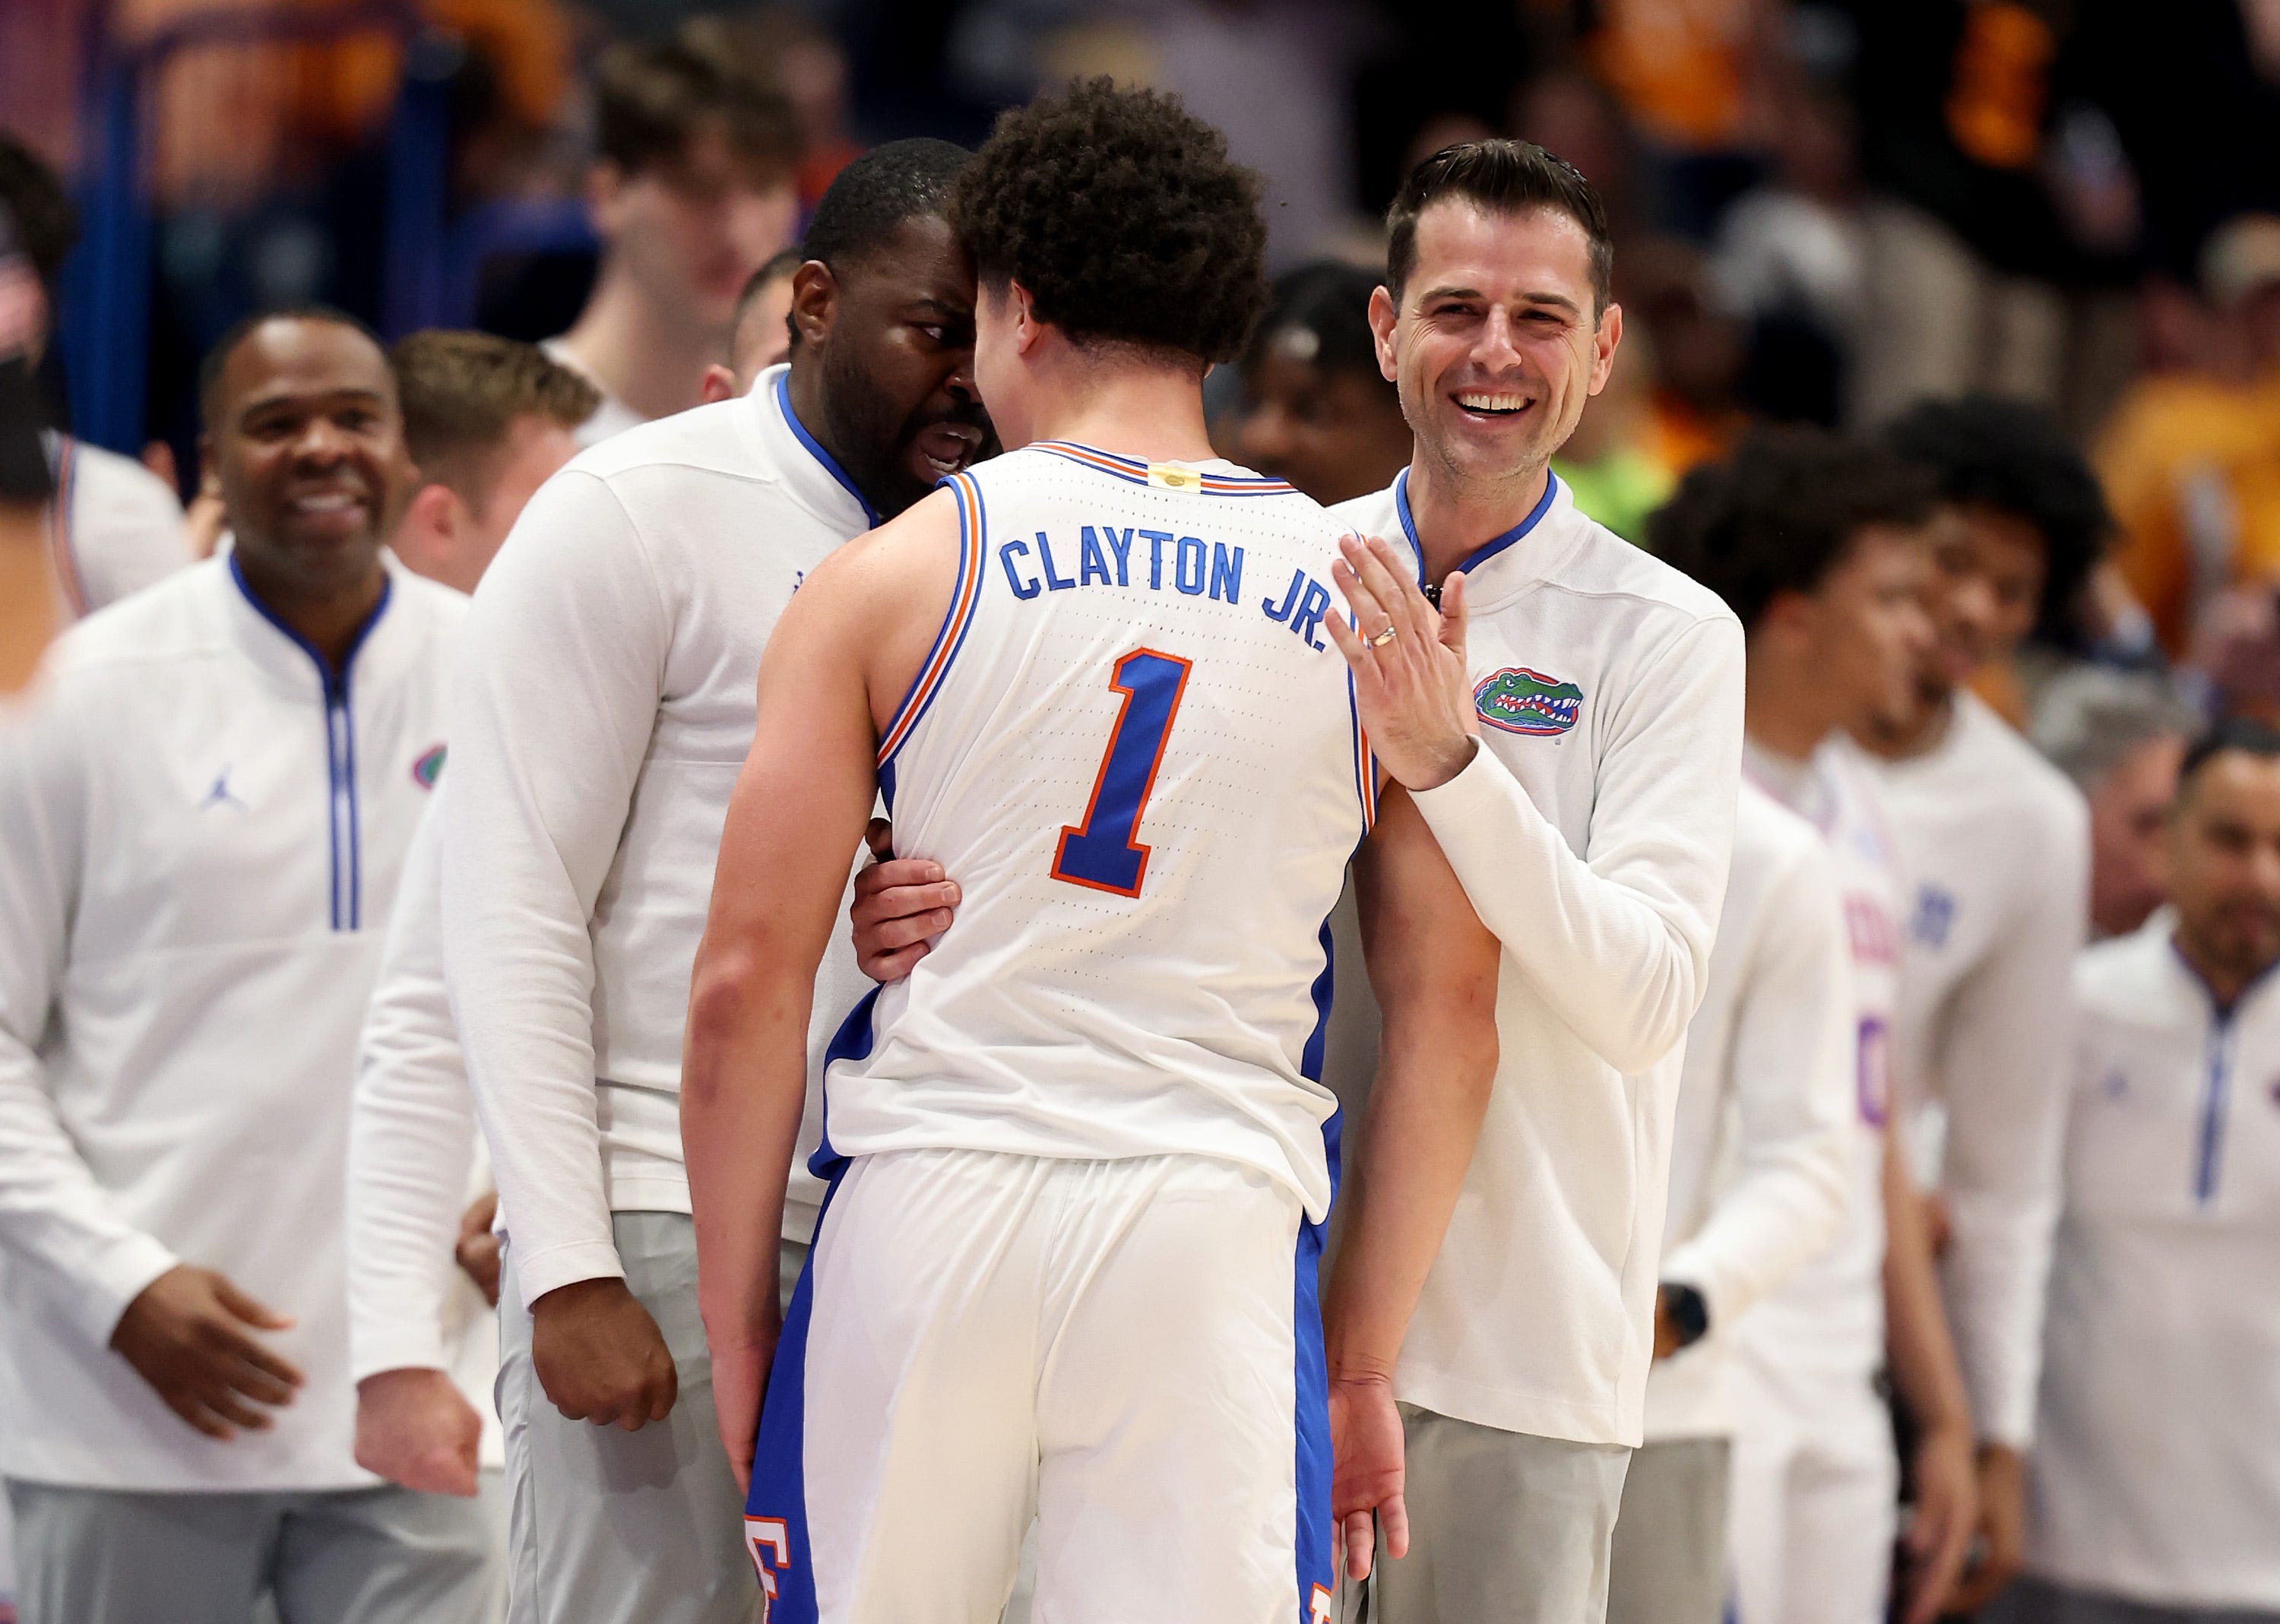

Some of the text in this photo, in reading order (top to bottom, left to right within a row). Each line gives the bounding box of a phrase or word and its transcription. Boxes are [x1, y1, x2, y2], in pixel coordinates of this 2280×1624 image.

[999, 526, 1332, 654] CLAYTON JR.
[1050, 646, 1193, 899] 1
